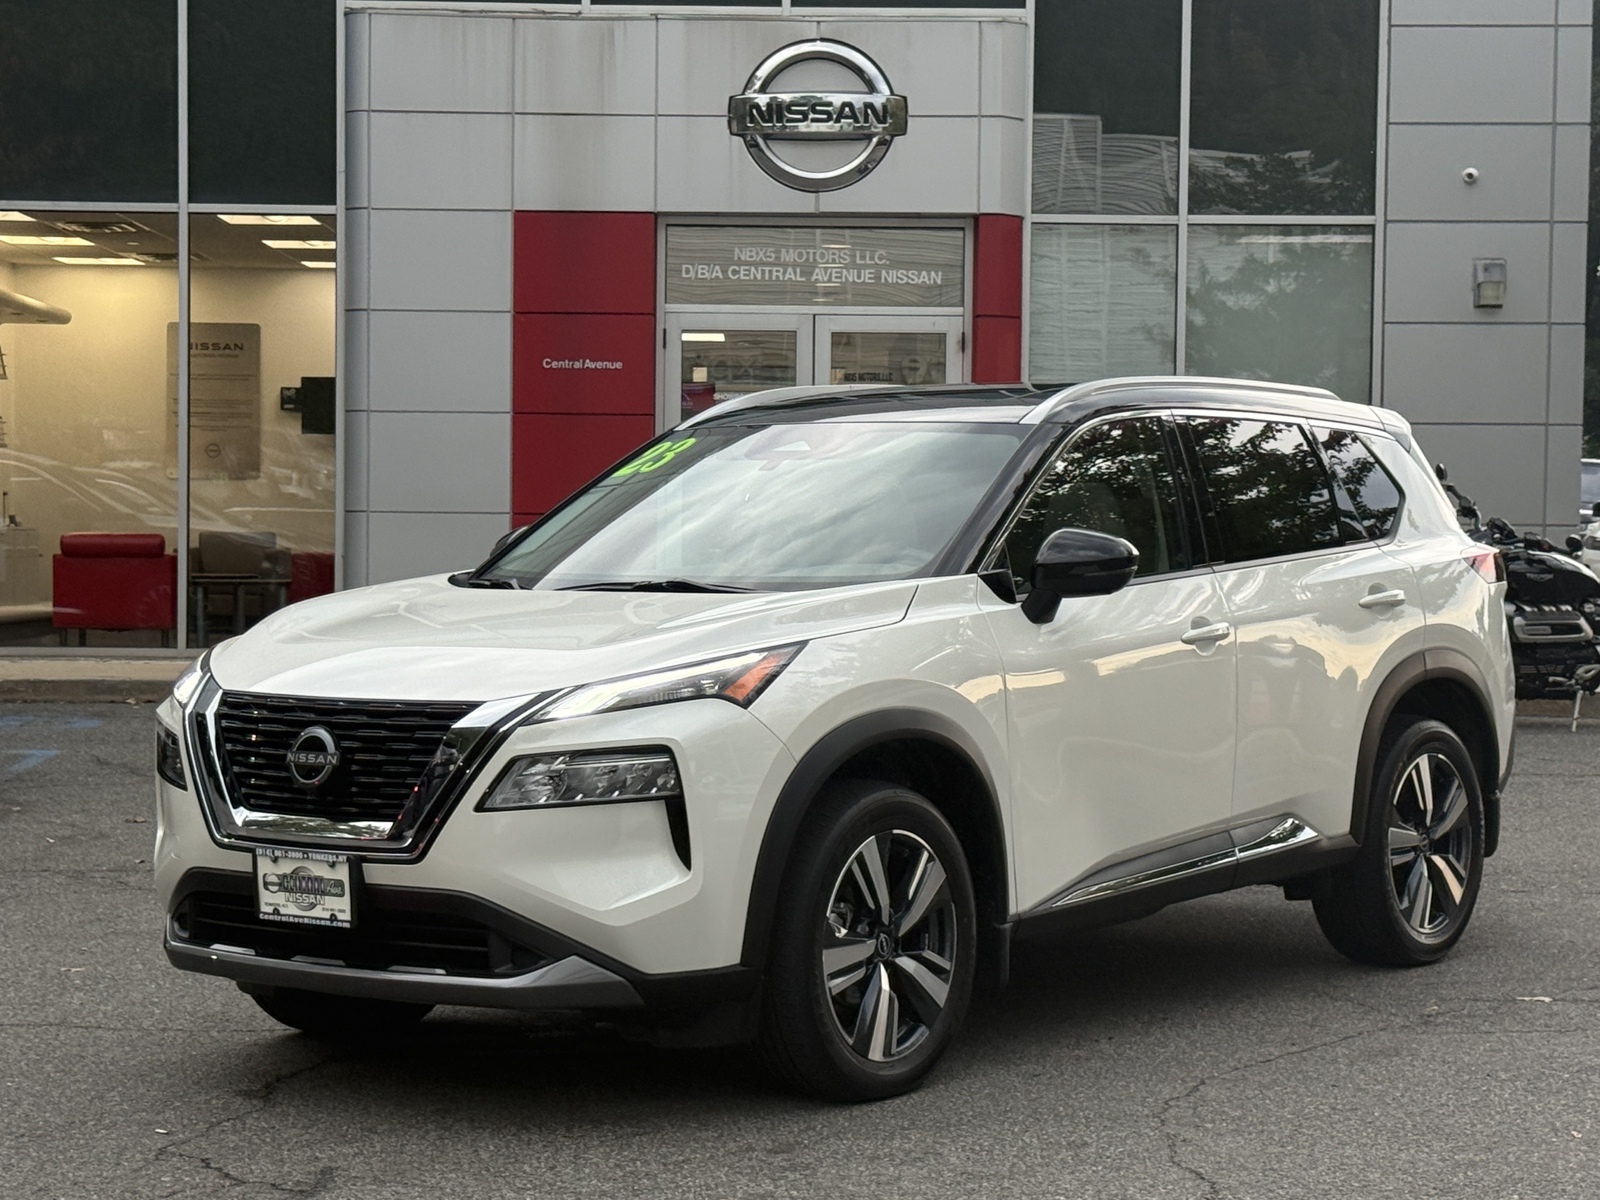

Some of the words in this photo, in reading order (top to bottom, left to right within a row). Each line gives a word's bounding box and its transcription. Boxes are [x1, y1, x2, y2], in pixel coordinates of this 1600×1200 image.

[747, 100, 889, 126] NISSAN
[780, 249, 850, 264] MOTORS
[856, 251, 890, 265] LLC.
[682, 264, 723, 280] D/B/A
[728, 265, 805, 281] CENTRAL
[811, 268, 875, 283] AVENUE
[881, 269, 942, 285] NISSAN
[543, 358, 583, 369] Central
[584, 359, 623, 370] Avenue
[286, 751, 338, 765] NISSAN
[284, 892, 326, 906] NISSAN
[259, 913, 351, 928] CentralAveNissan.com
